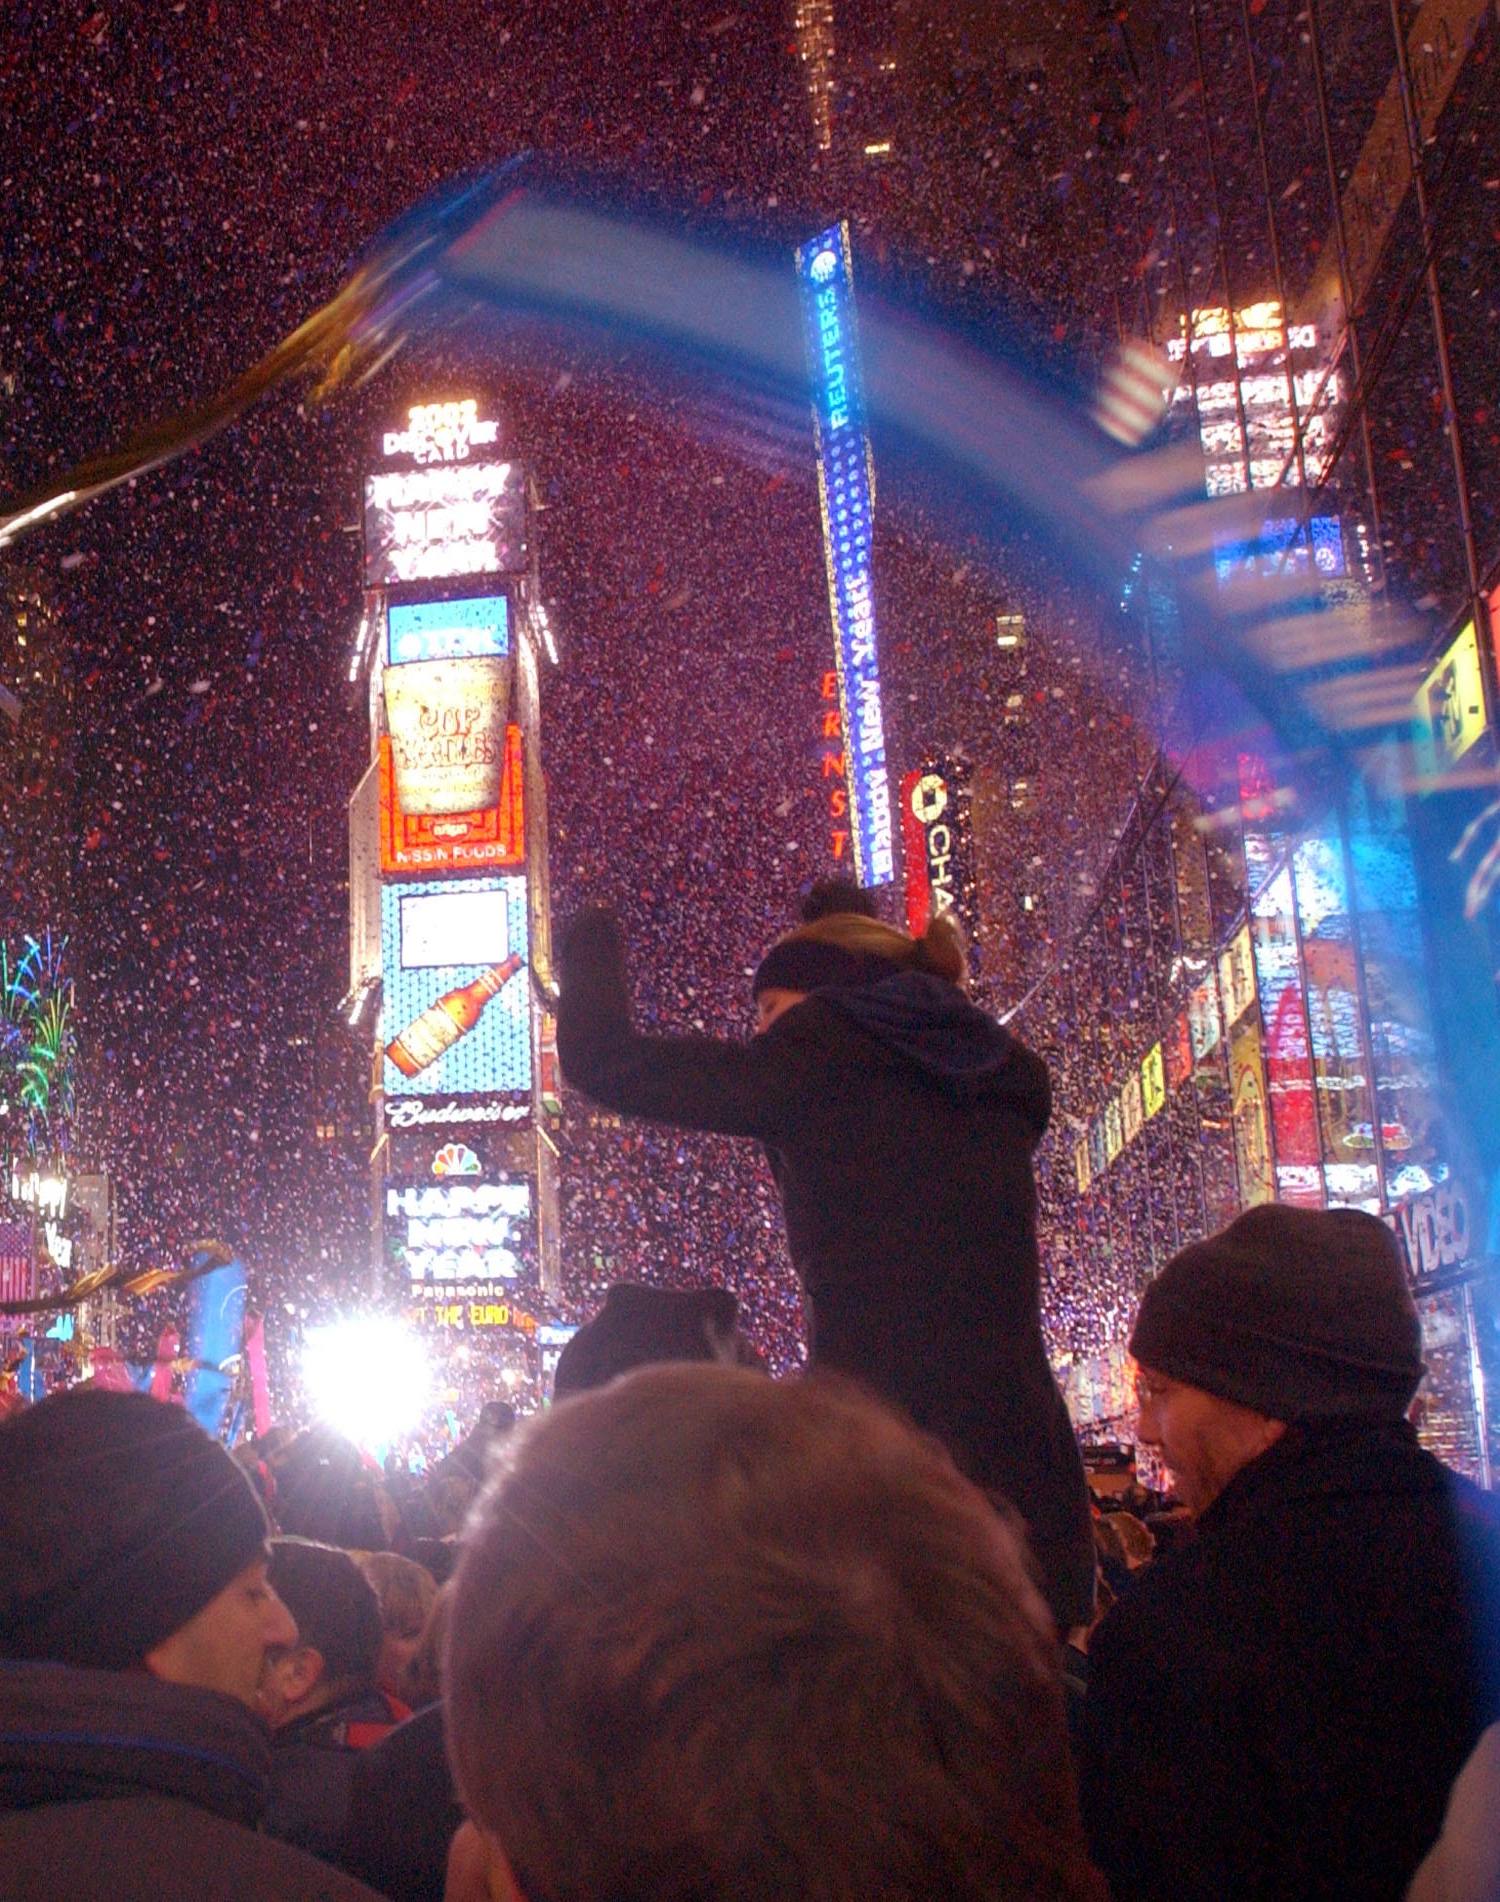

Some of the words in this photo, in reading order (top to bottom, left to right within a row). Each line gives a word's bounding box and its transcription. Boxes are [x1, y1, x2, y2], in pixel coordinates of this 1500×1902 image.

[817, 286, 849, 430] REUTERS
[859, 680, 885, 753] New
[396, 849, 448, 863] NISSIN
[453, 844, 507, 860] FOODS
[929, 824, 956, 924] CHA
[384, 1100, 531, 1128] Budweiser
[411, 1283, 505, 1299] Panasonic
[470, 1304, 509, 1325] EURO
